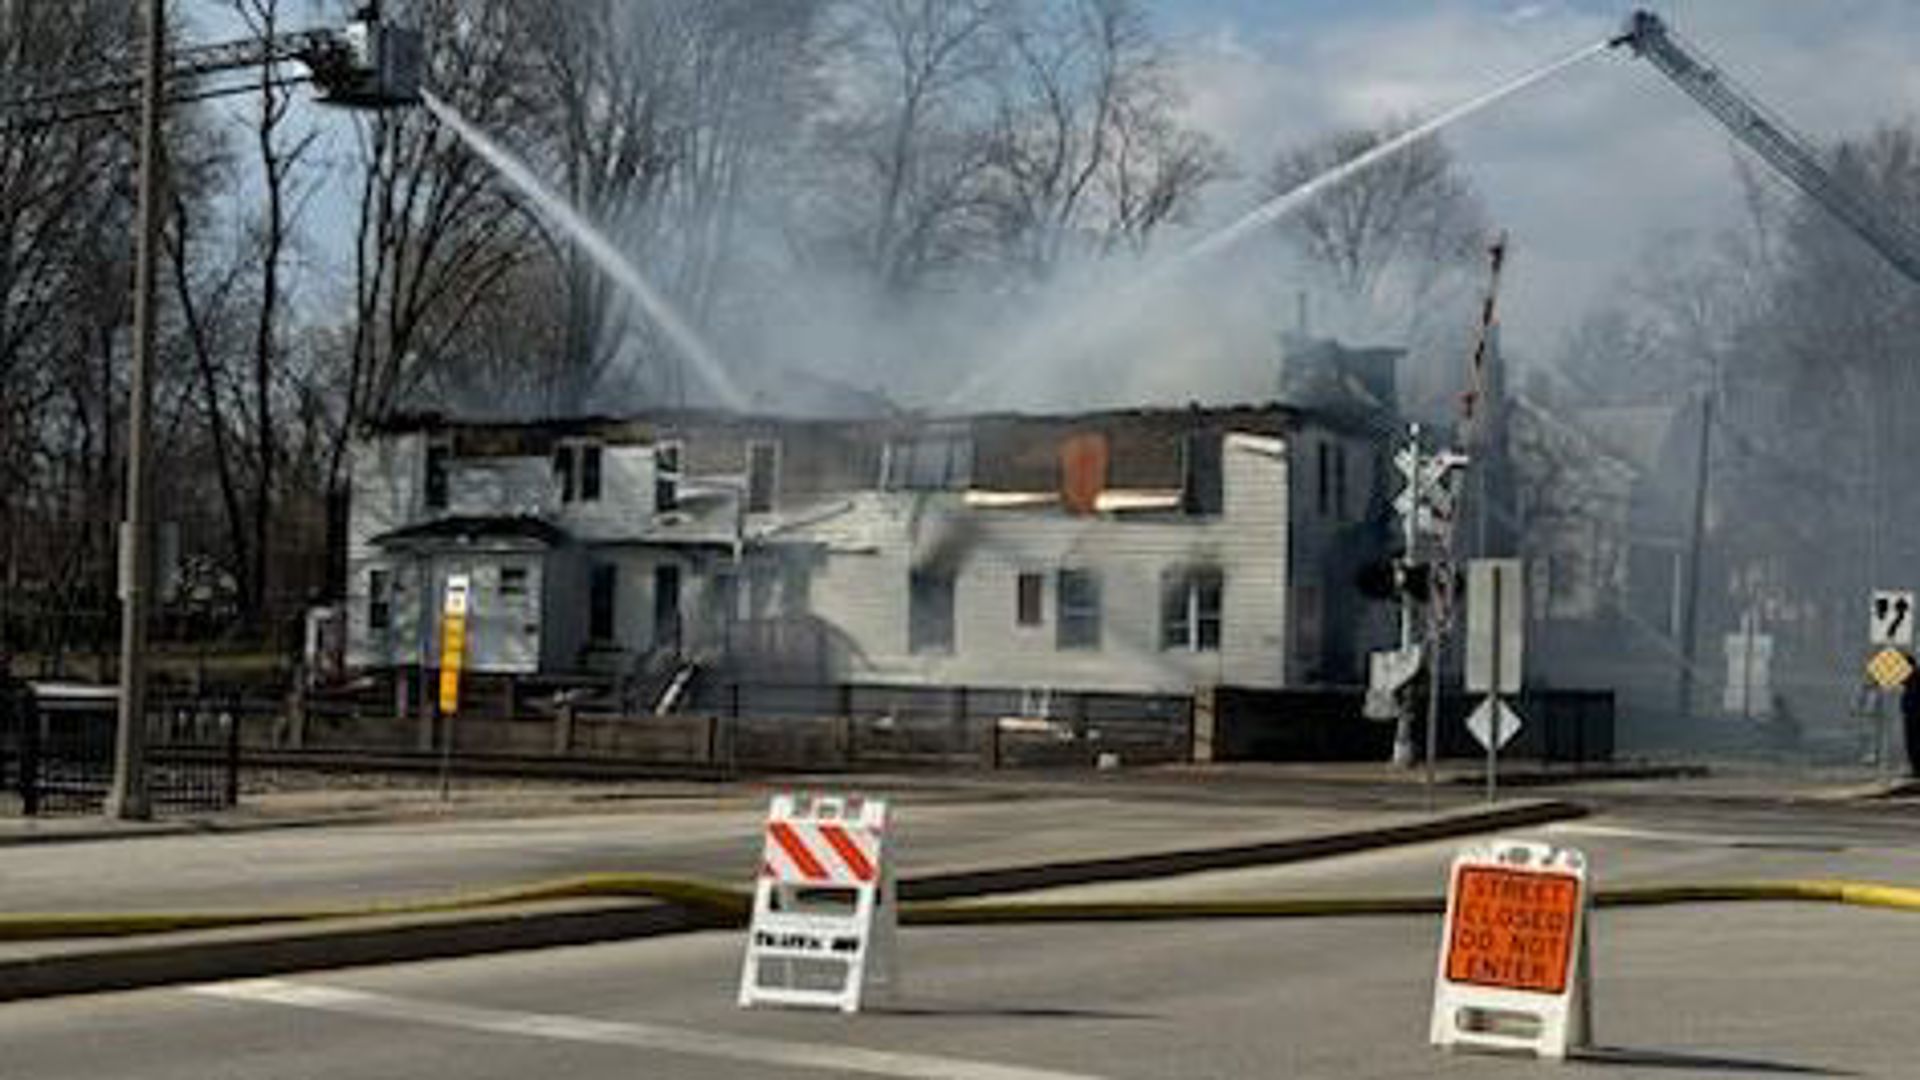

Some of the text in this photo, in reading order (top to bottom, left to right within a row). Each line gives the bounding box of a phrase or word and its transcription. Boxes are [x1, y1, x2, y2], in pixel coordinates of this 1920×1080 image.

[1467, 876, 1566, 904] STREET
[1463, 901, 1565, 933] CLOSED
[1458, 928, 1561, 958] DO NOT
[1465, 955, 1548, 984] ENTER
